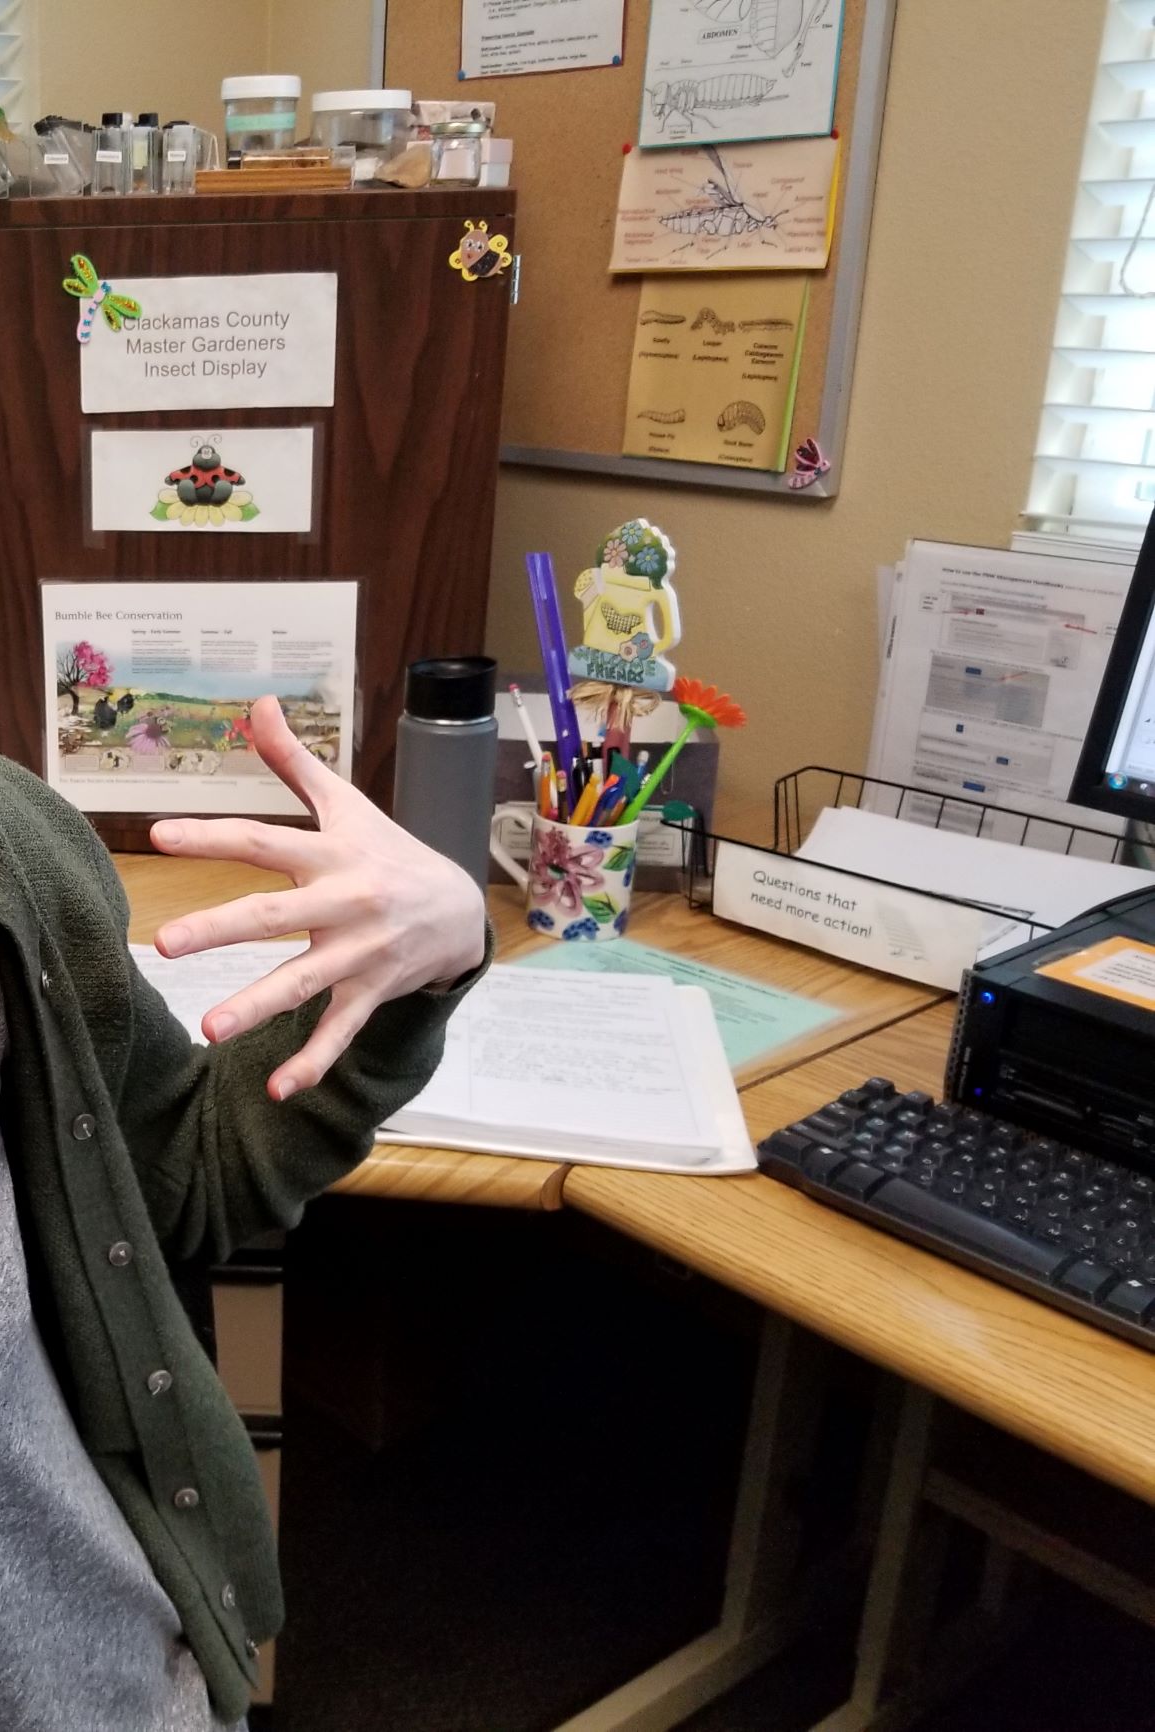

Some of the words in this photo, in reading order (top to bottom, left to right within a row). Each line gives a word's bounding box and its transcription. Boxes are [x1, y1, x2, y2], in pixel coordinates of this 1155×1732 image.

[701, 28, 739, 40] ABDOMEN
[123, 311, 220, 331] Clackamas
[226, 311, 290, 330] County
[126, 337, 186, 354] Master
[192, 335, 285, 352] Gardeners
[144, 360, 196, 378] Insect
[203, 358, 267, 379] Display
[55, 610, 93, 621] Bumble
[95, 610, 113, 620] Bee
[116, 610, 183, 621] Conservation
[587, 664, 645, 684] FRIENDS
[753, 870, 821, 901] Questions
[826, 892, 858, 912] that
[750, 891, 782, 911] need
[784, 904, 820, 923] more
[823, 915, 873, 938] action!
